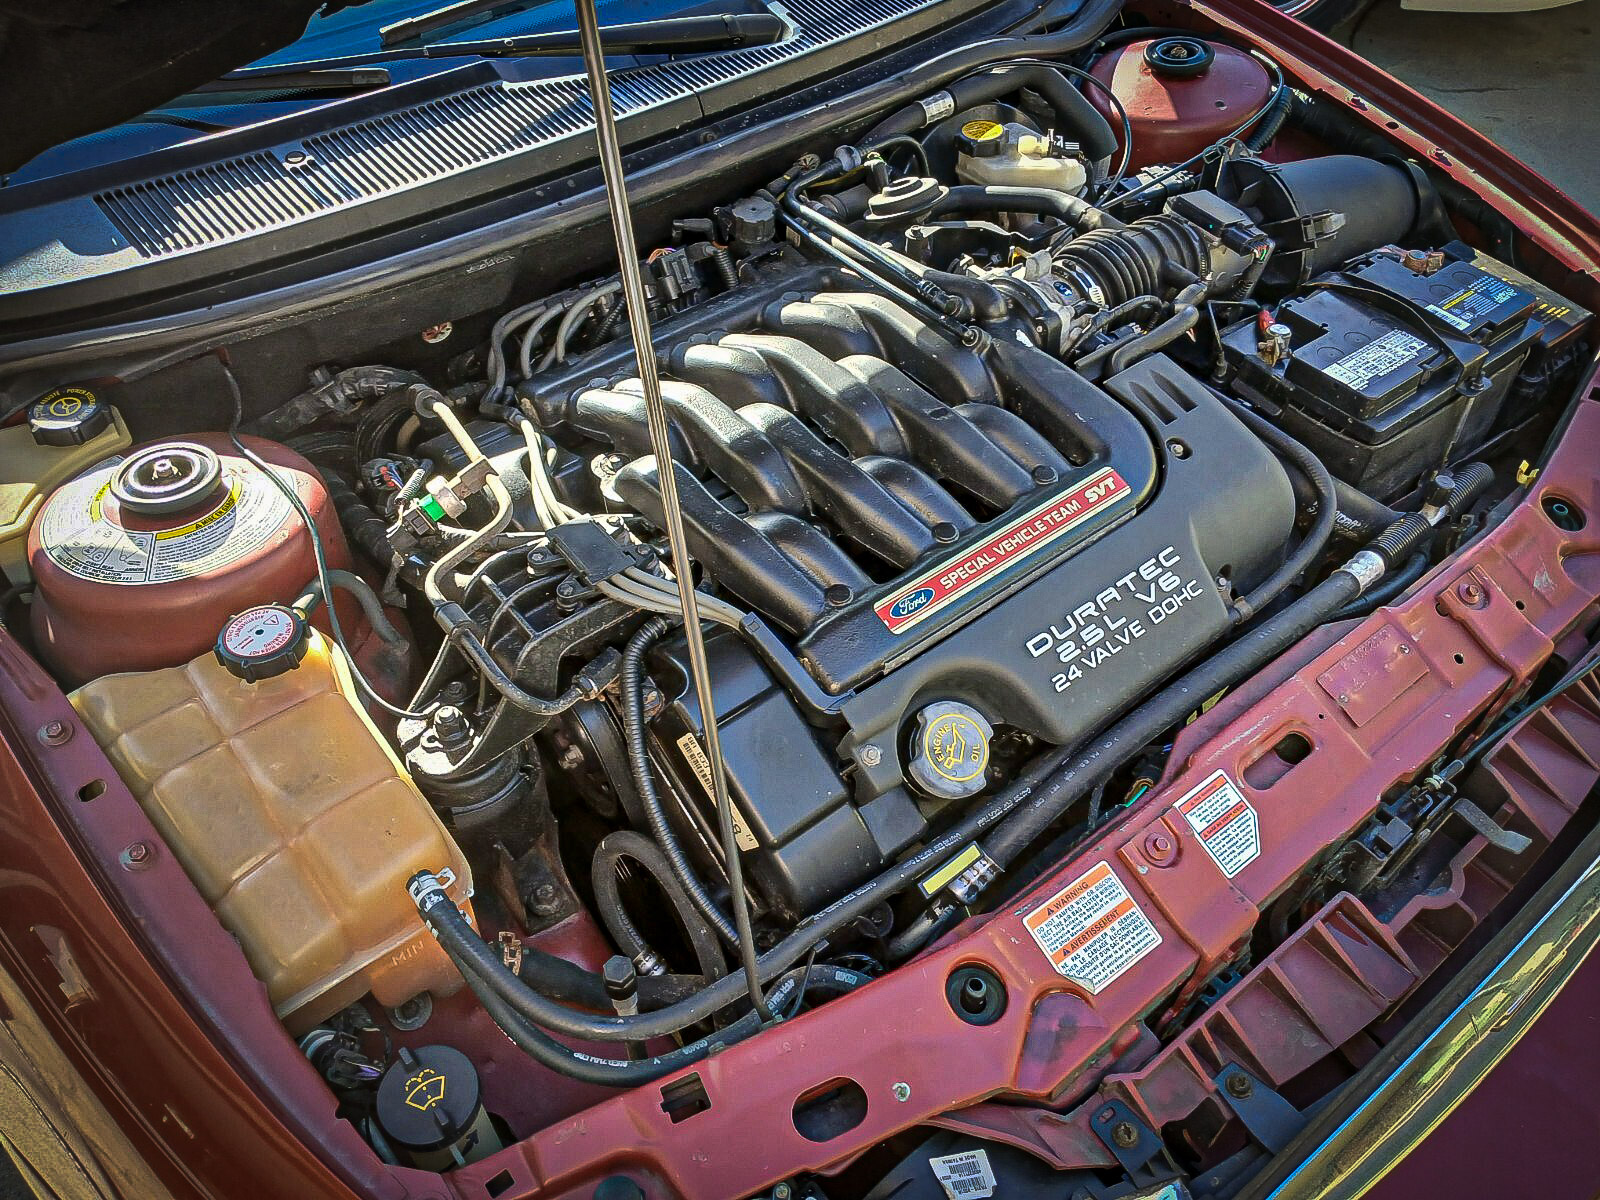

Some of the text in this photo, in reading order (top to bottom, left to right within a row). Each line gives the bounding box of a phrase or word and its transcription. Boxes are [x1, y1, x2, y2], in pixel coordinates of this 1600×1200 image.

[939, 477, 1117, 590] SPECIAL VEHICLE TEAM SVT
[898, 593, 927, 616] Ford
[1025, 546, 1181, 658] DURATEC
[1134, 571, 1181, 604] V6
[1051, 579, 1204, 693] 24 VALVE DOHC
[933, 723, 951, 763] ENGINE
[970, 744, 981, 762] OIL
[1036, 926, 1045, 934] DO
[1044, 918, 1055, 928] NOT
[1055, 904, 1075, 920] TAMPER
[1074, 895, 1087, 906] WITH
[1053, 882, 1089, 910] WARNING
[1039, 928, 1053, 940] NECT
[1053, 921, 1063, 930] THE
[1062, 914, 1072, 923] AIR
[1071, 907, 1083, 917] BAG
[1081, 894, 1100, 909] SYSTEM
[1069, 909, 1120, 951] AVERTISSEMENT
[391, 940, 424, 966] MIN
[1060, 962, 1069, 970] NE
[1070, 953, 1081, 962] PAS
[1082, 932, 1108, 953] MANIPULER
[1075, 955, 1100, 976] DISPOSITIF
[1109, 940, 1120, 949] SAC
